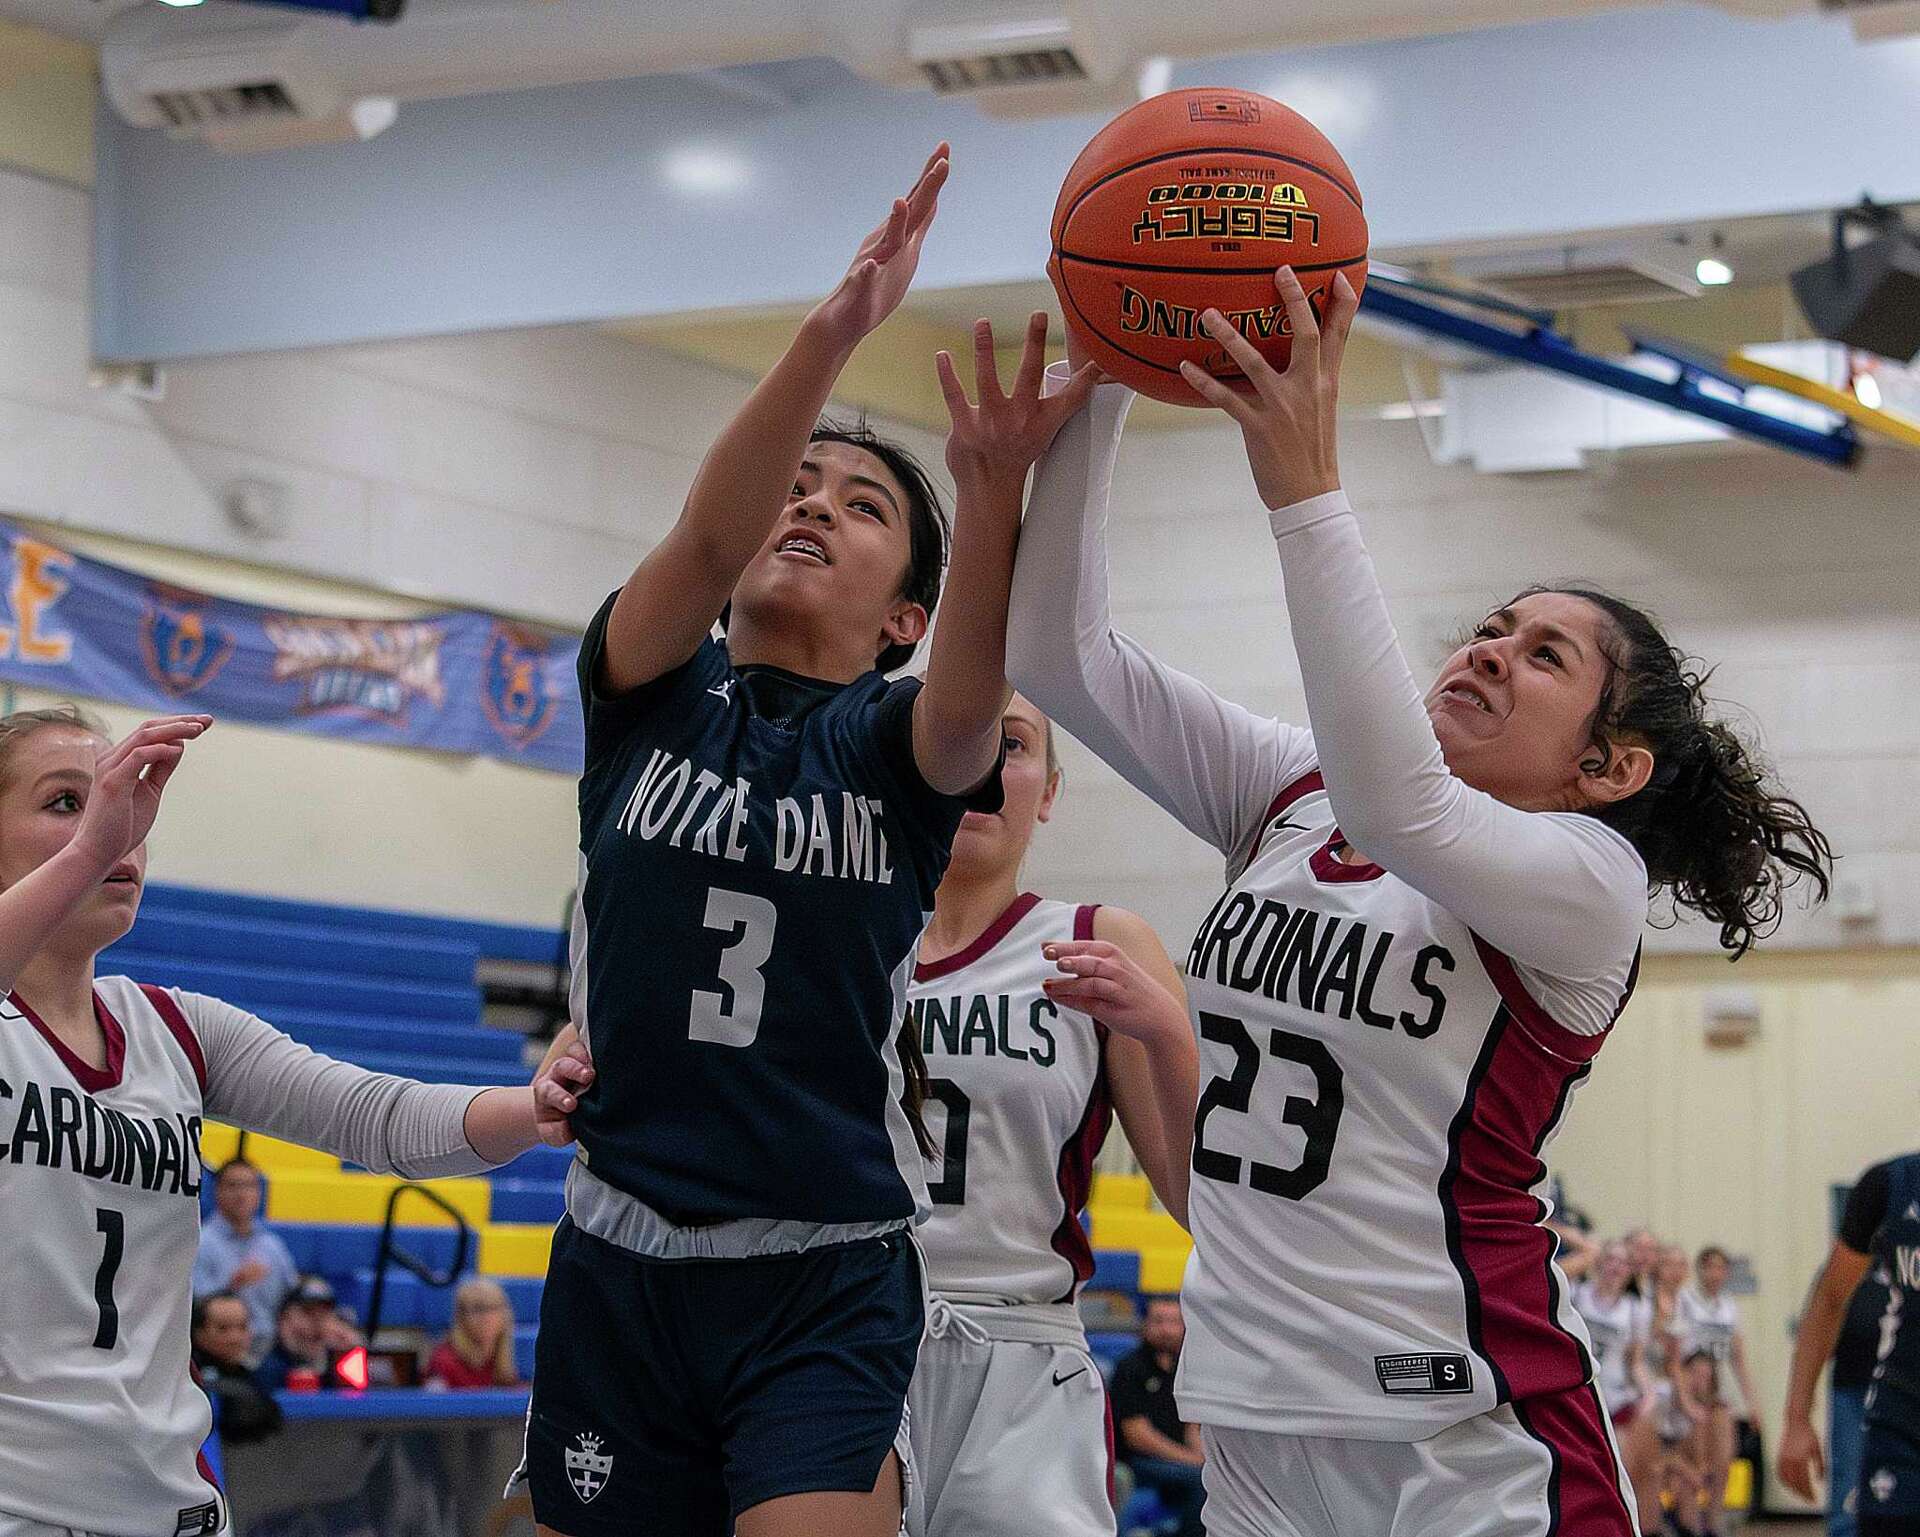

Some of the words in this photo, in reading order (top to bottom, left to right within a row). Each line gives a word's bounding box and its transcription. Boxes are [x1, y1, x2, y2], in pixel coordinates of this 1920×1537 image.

[1131, 206, 1320, 246] LEGACY
[617, 749, 751, 862] NOTRE
[774, 791, 894, 885] DAME
[688, 886, 777, 1048] 3
[1192, 1010, 1344, 1201] 23
[93, 1207, 125, 1350] 1
[1443, 1364, 1456, 1381] S
[207, 1512, 215, 1528] S
